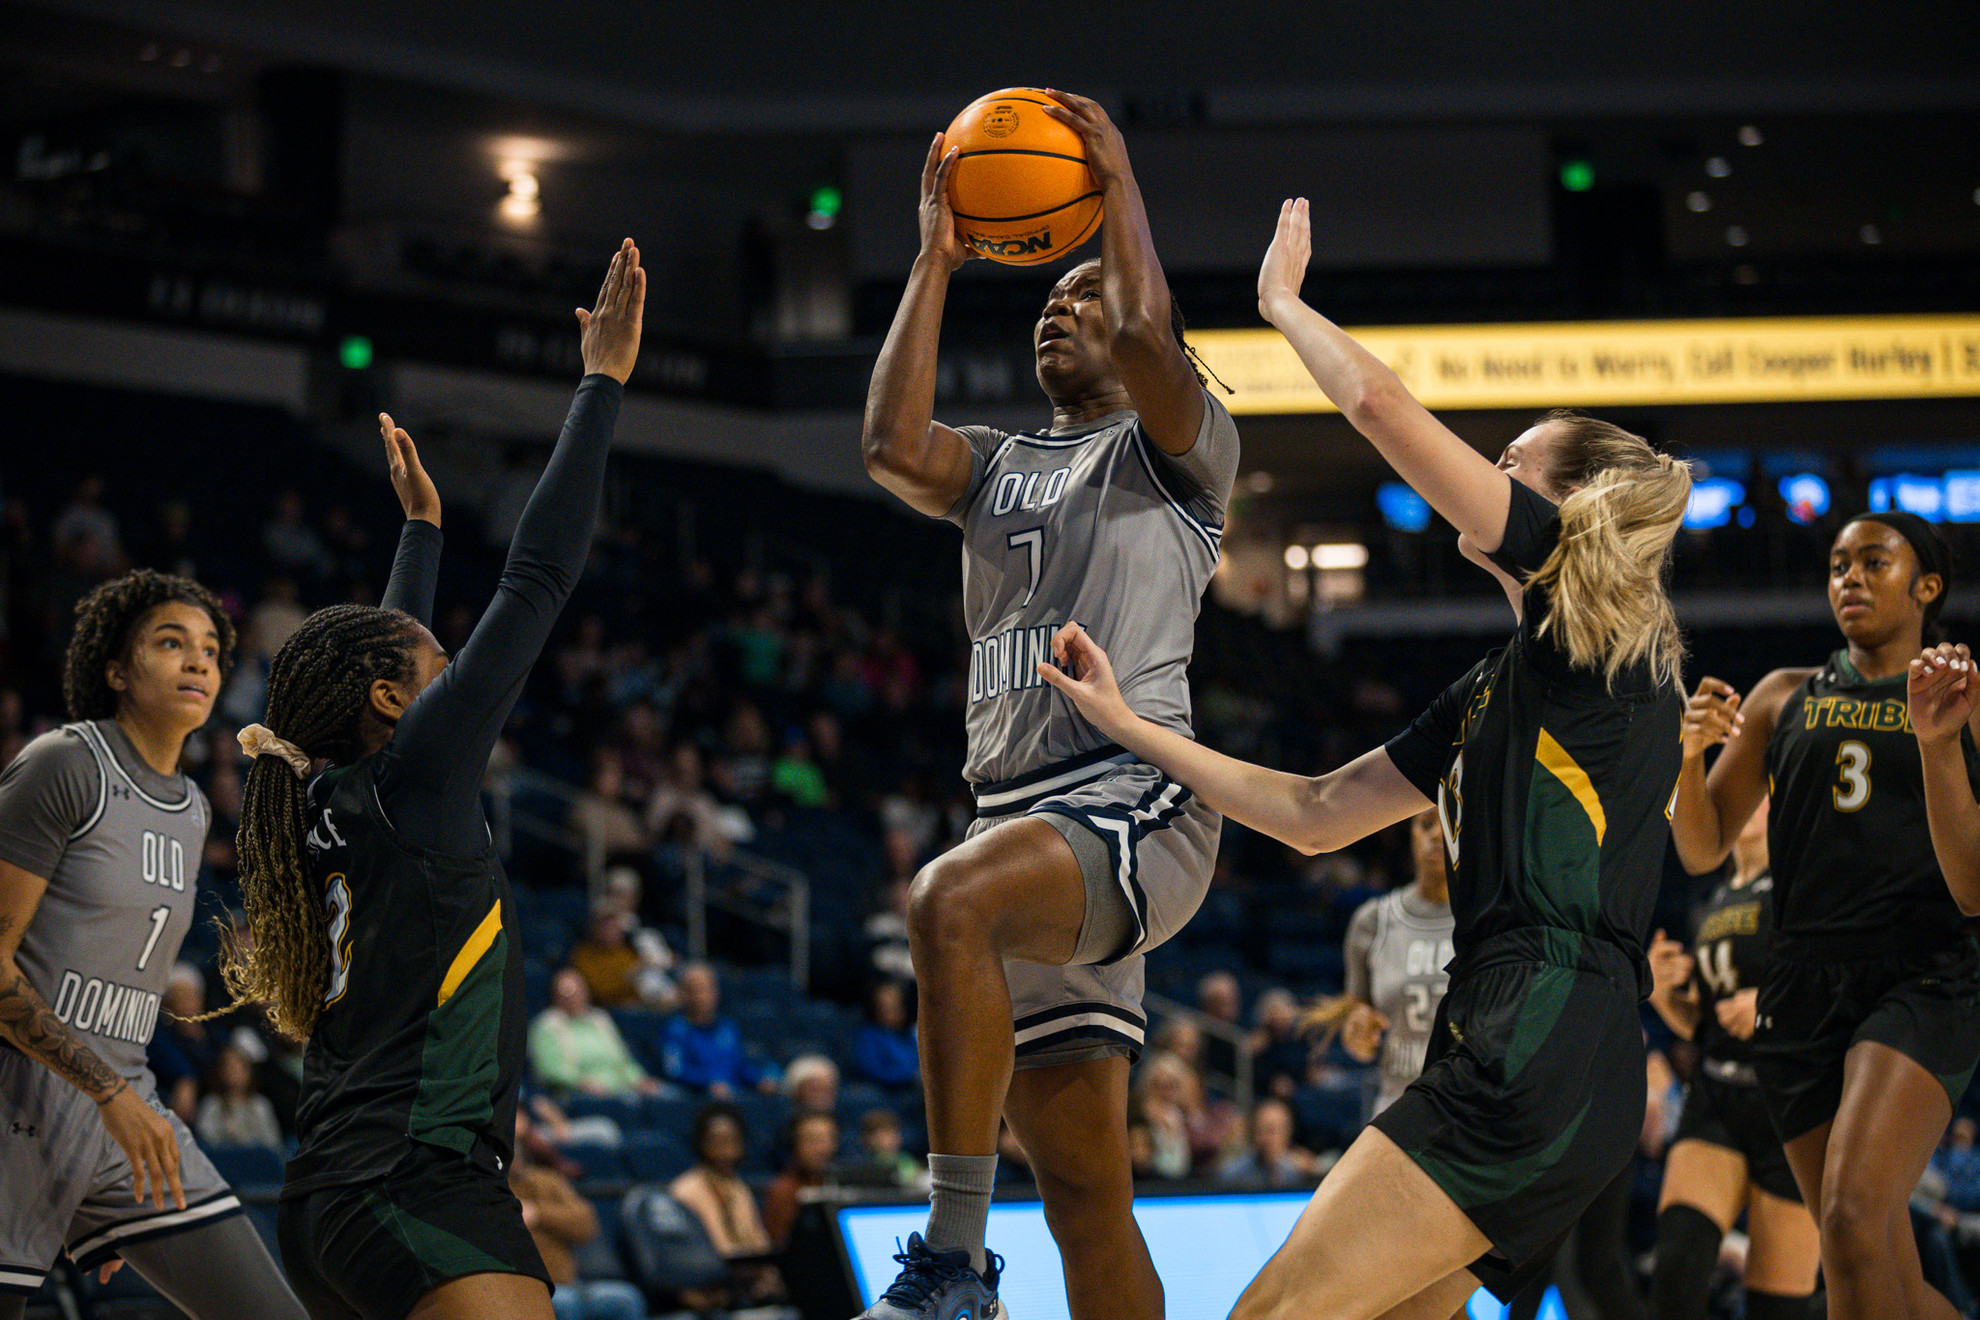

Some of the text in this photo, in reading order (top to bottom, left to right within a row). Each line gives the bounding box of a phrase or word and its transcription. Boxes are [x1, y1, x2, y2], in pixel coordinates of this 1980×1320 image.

[967, 231, 1053, 256] NCAA
[991, 467, 1071, 517] OLD
[1006, 525, 1044, 608] 7
[1832, 740, 1872, 813] 3
[141, 829, 185, 892] OLD
[136, 905, 170, 971] 1
